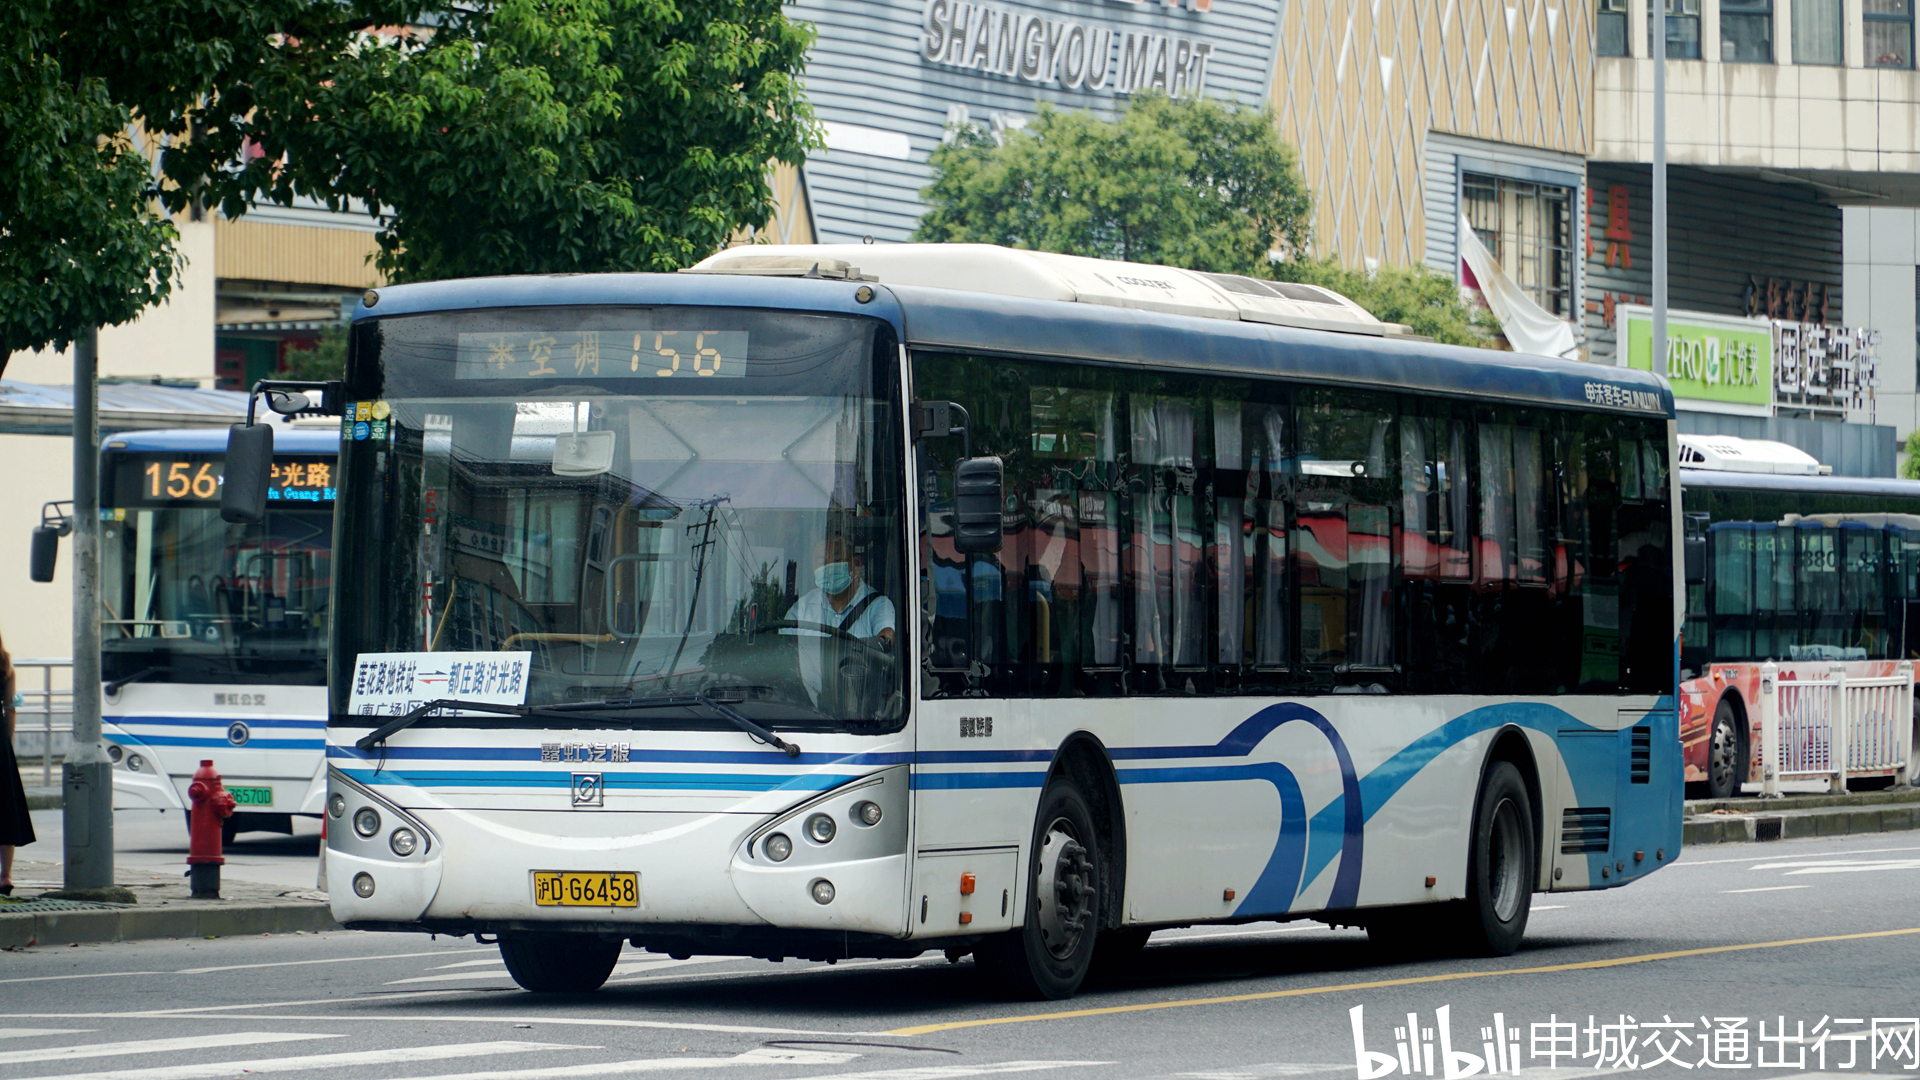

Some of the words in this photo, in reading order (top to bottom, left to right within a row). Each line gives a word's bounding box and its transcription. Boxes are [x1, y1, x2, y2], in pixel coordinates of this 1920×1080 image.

[919, 0, 1113, 92] SHANGYOU
[1114, 29, 1214, 101] MART
[1586, 185, 1633, 270] 具
[527, 331, 600, 377] 空调
[630, 331, 721, 377] 156
[1650, 336, 1703, 380] ZERO
[1584, 381, 1623, 406] 申沃客车
[1621, 389, 1661, 410] SUNWIN
[145, 462, 217, 498] 156
[284, 487, 319, 501] Guang
[356, 660, 417, 696] 莲花路地铁站
[447, 660, 523, 695] 都庄路沪光路
